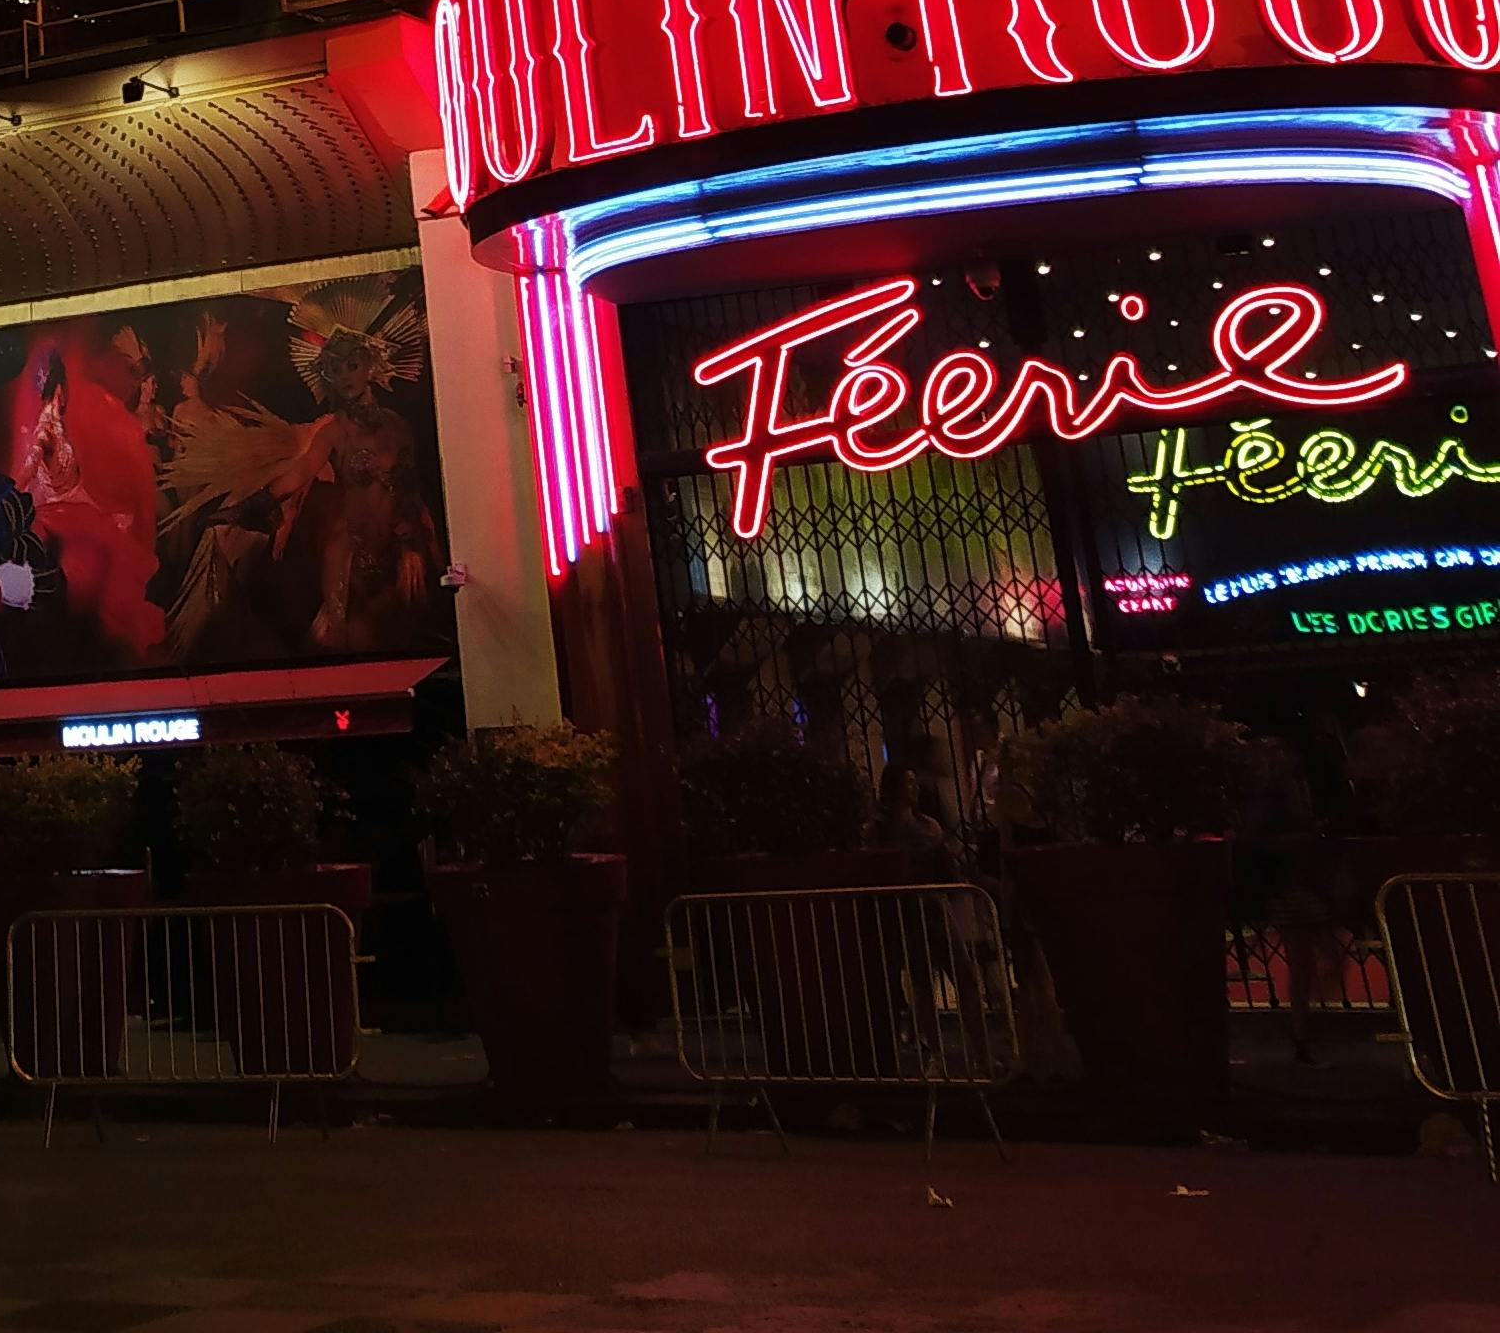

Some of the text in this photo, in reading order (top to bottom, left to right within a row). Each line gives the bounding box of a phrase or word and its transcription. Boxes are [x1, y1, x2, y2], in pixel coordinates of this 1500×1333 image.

[694, 280, 1405, 539] Féerie
[1127, 405, 1500, 539] Féeri
[1290, 609, 1341, 634] LES
[63, 719, 199, 747] MOULIN ROUGE
